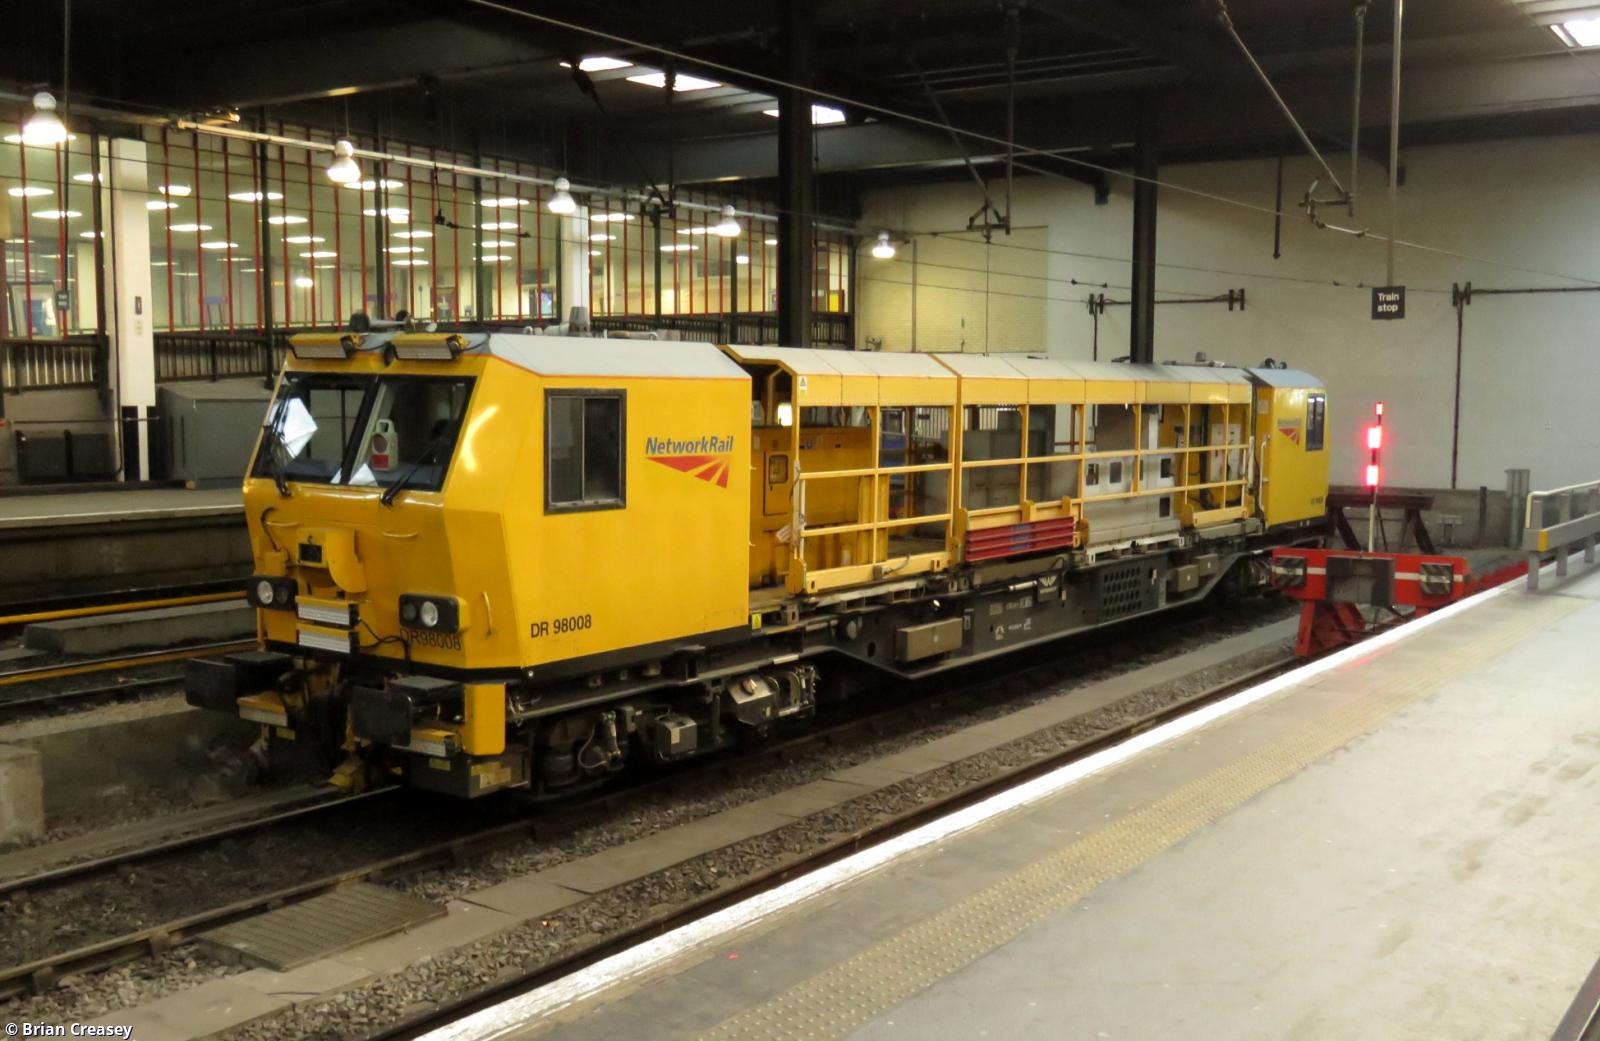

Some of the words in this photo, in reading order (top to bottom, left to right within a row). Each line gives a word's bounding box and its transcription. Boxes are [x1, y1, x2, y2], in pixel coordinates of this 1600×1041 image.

[1377, 292, 1400, 301] Train
[1377, 304, 1399, 313] stop
[531, 621, 549, 638] DR
[553, 613, 592, 635] 98008
